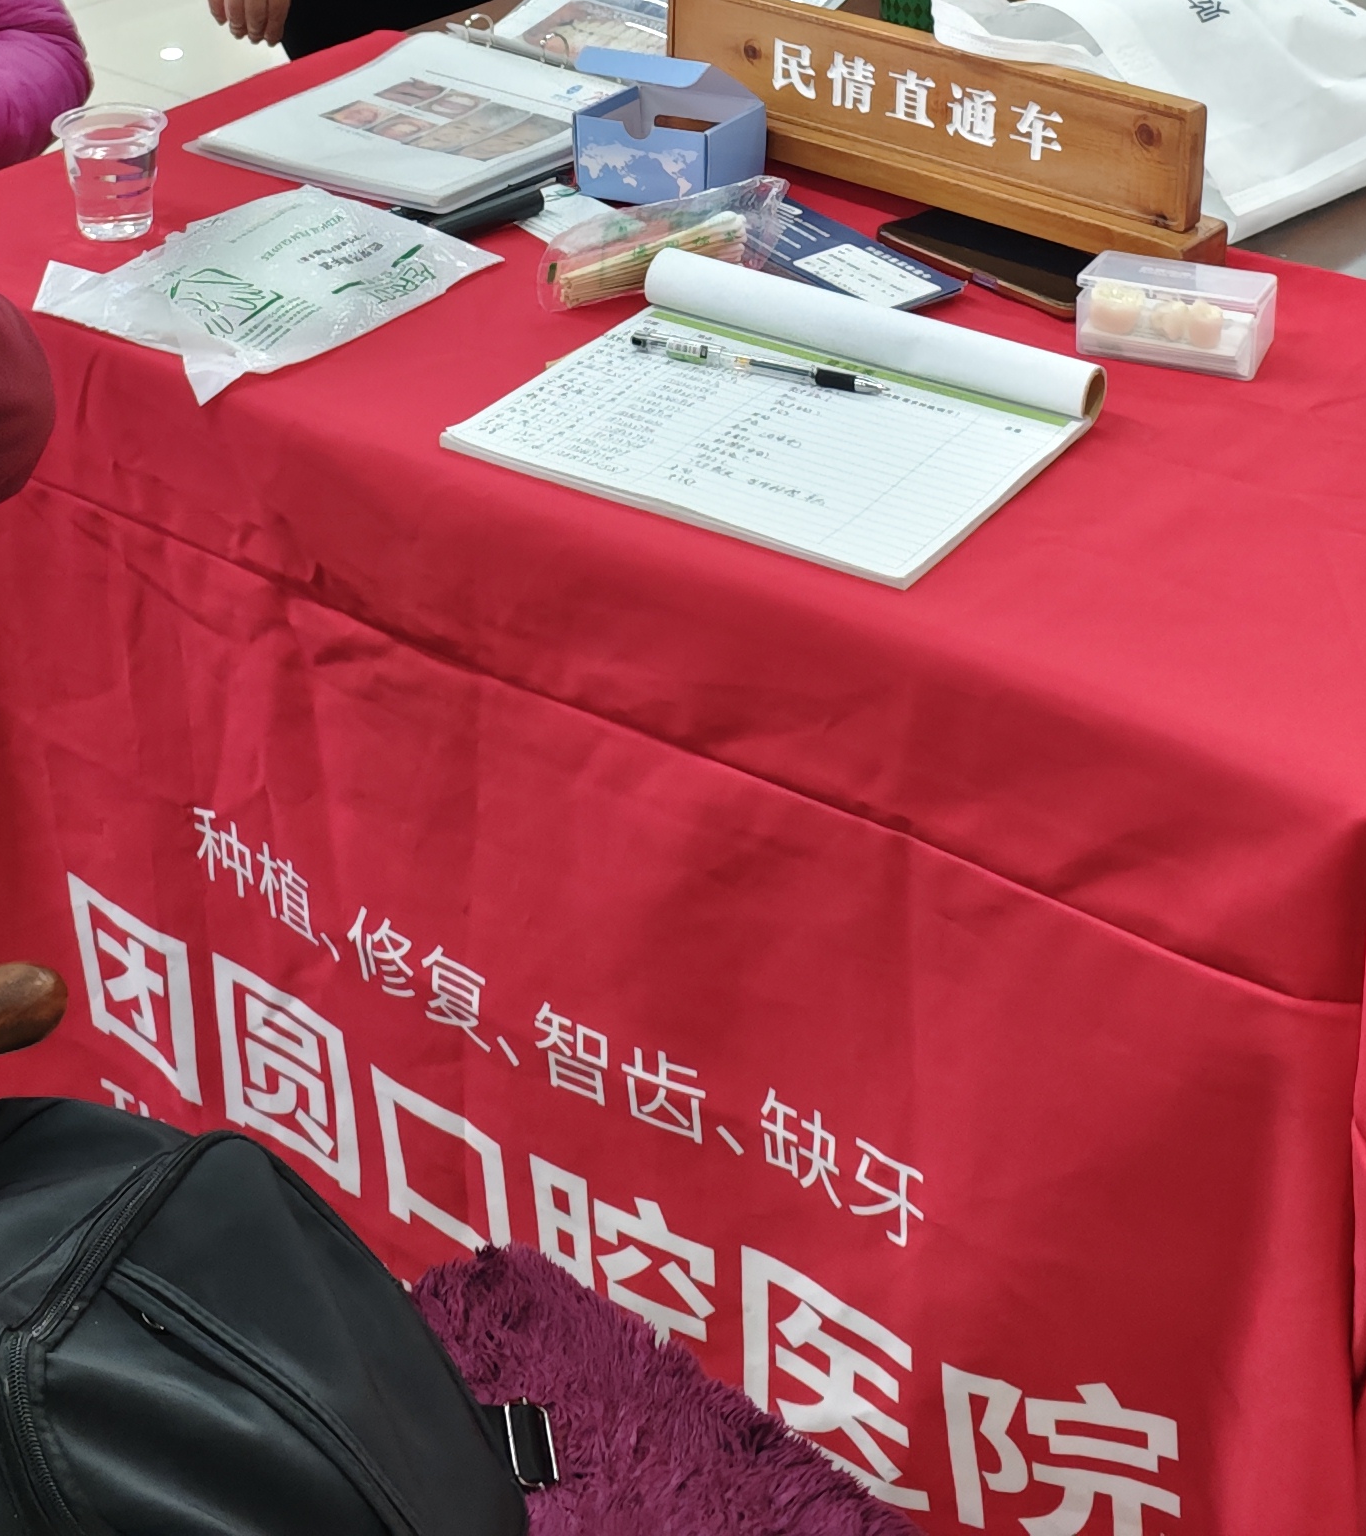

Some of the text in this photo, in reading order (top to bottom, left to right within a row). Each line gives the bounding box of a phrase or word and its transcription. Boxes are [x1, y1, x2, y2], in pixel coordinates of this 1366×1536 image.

[770, 37, 1064, 162] 民情直通车
[65, 870, 1182, 1536] 团圆口腔医院
